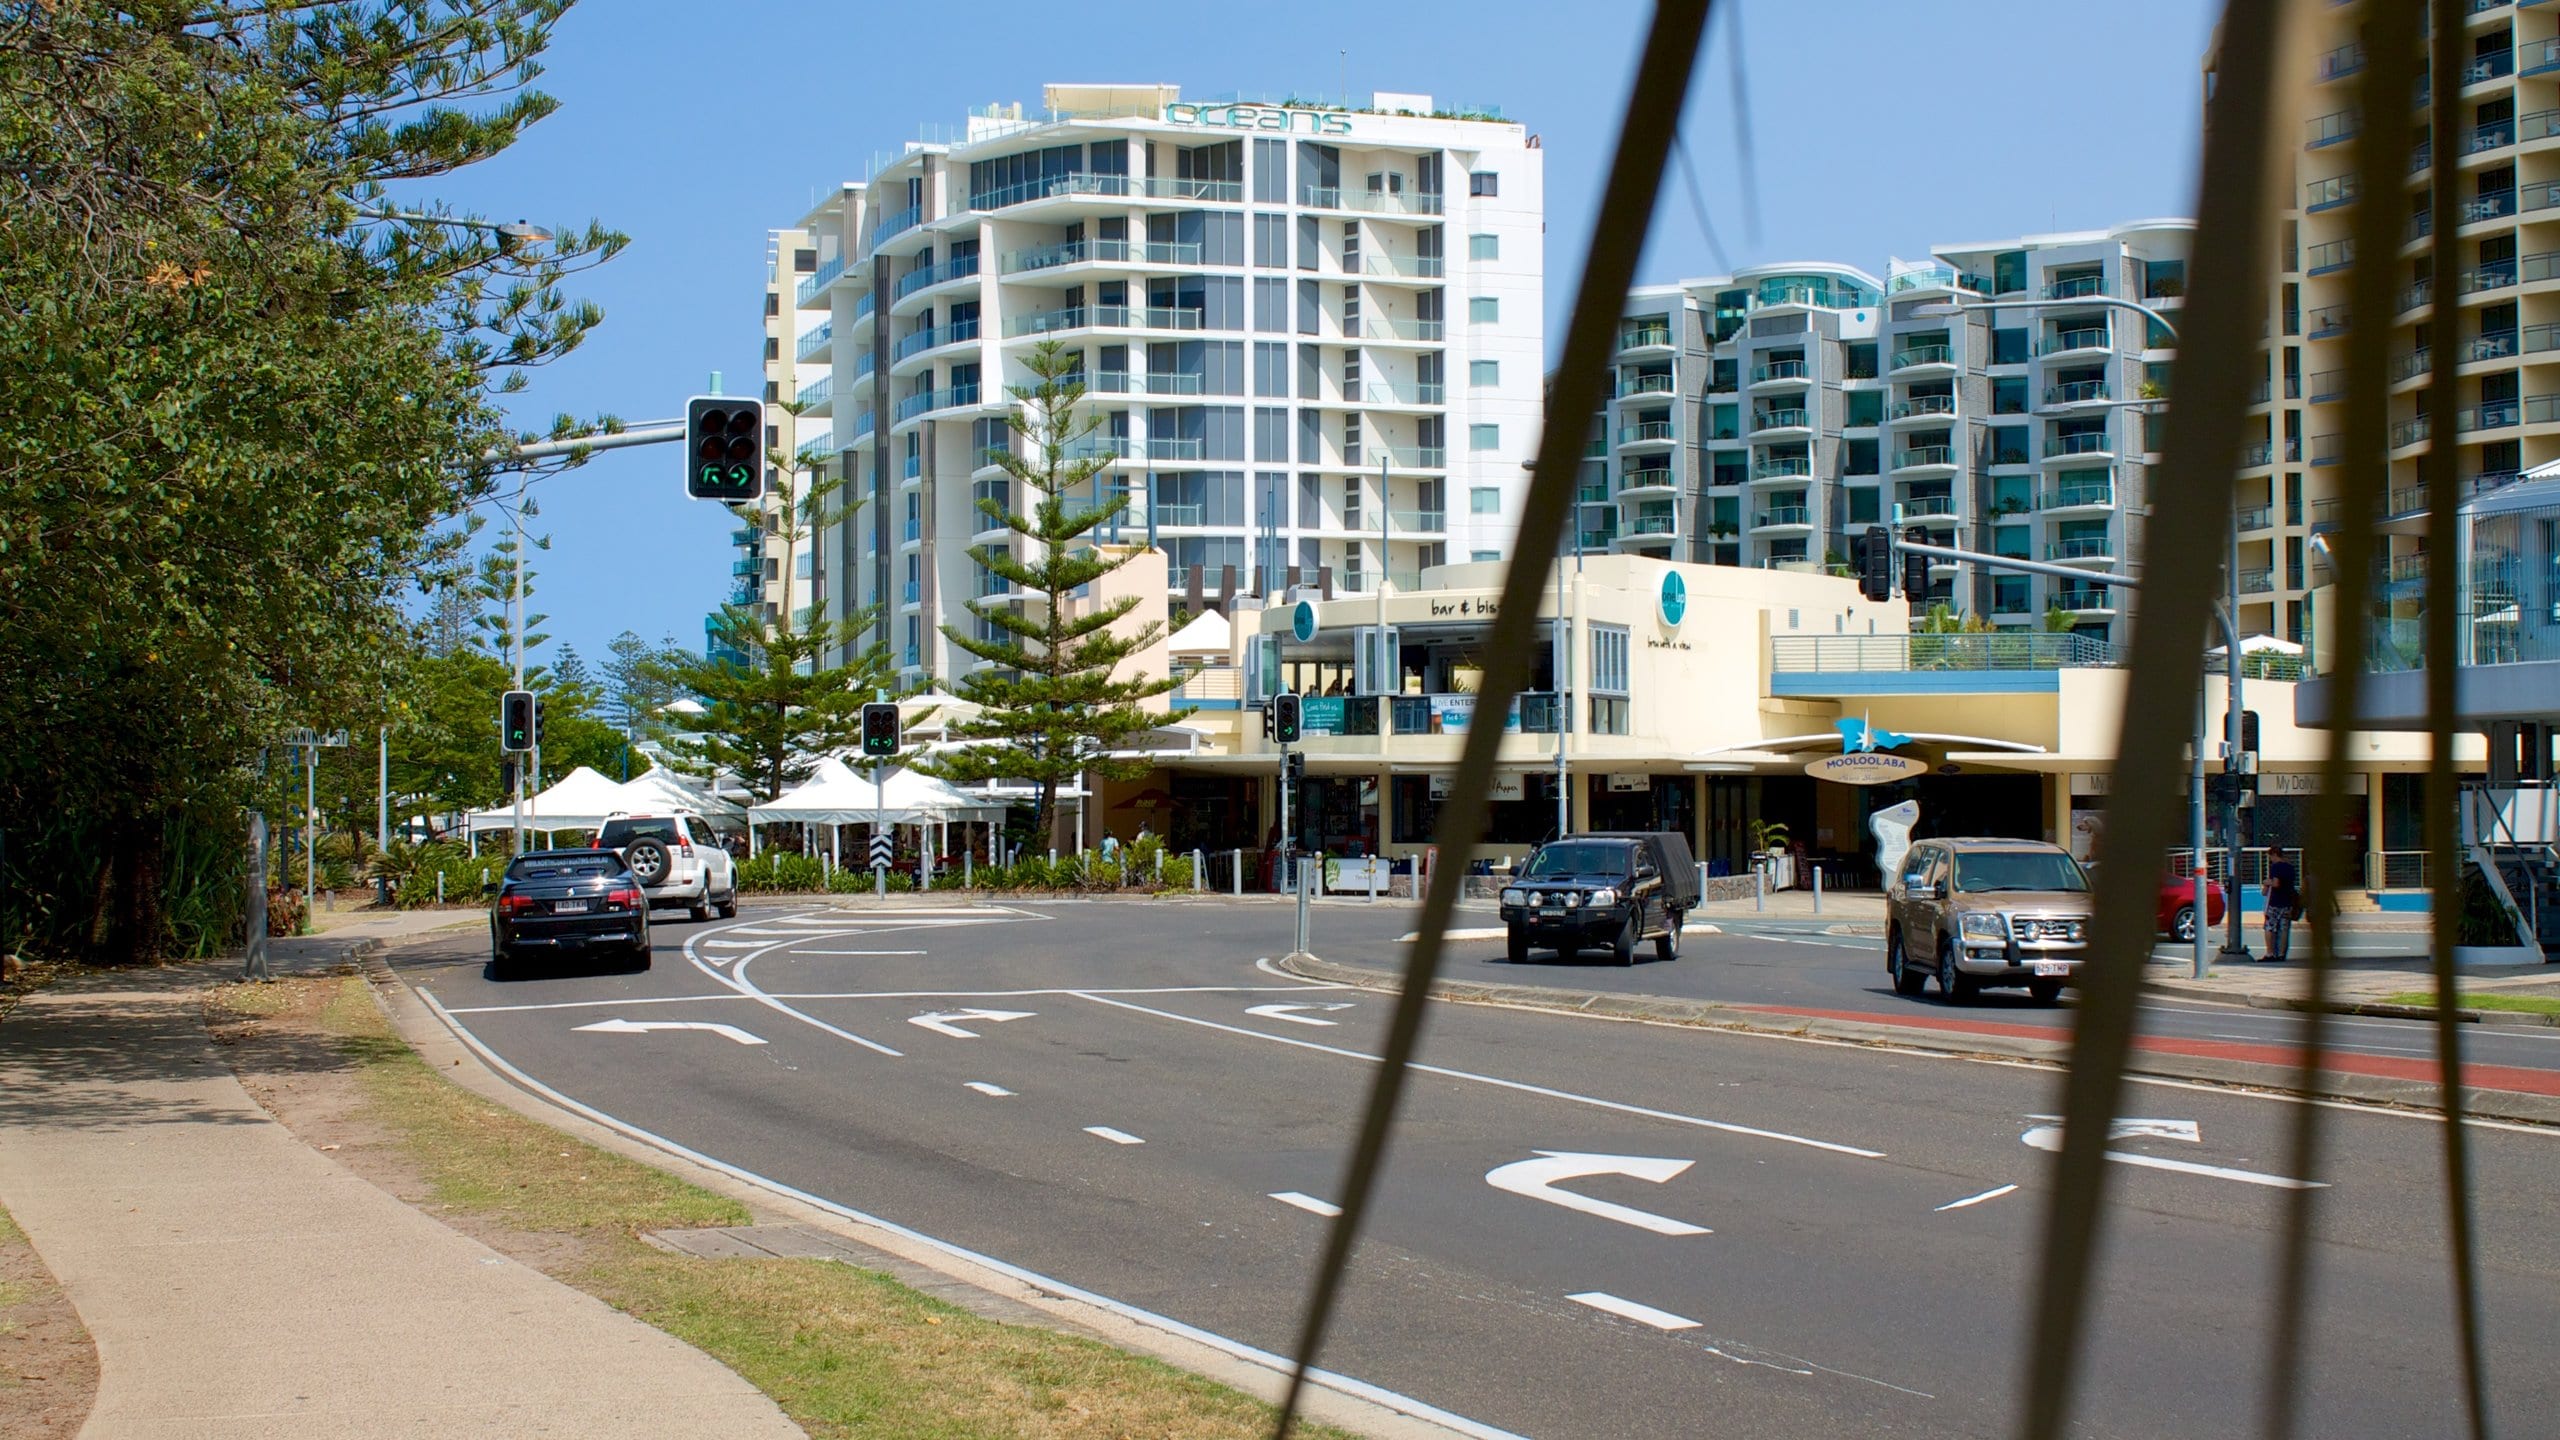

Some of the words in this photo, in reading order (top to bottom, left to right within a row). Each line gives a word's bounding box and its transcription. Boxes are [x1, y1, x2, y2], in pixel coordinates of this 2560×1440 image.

[1166, 103, 1352, 135] oceans
[1431, 598, 1455, 616] bar
[1460, 599, 1470, 616] &
[1476, 597, 1502, 615] bis
[1449, 699, 1476, 707] ENTER
[335, 731, 346, 744] ST
[1826, 756, 1907, 770] MOOLOOLABA
[2276, 775, 2290, 793] My
